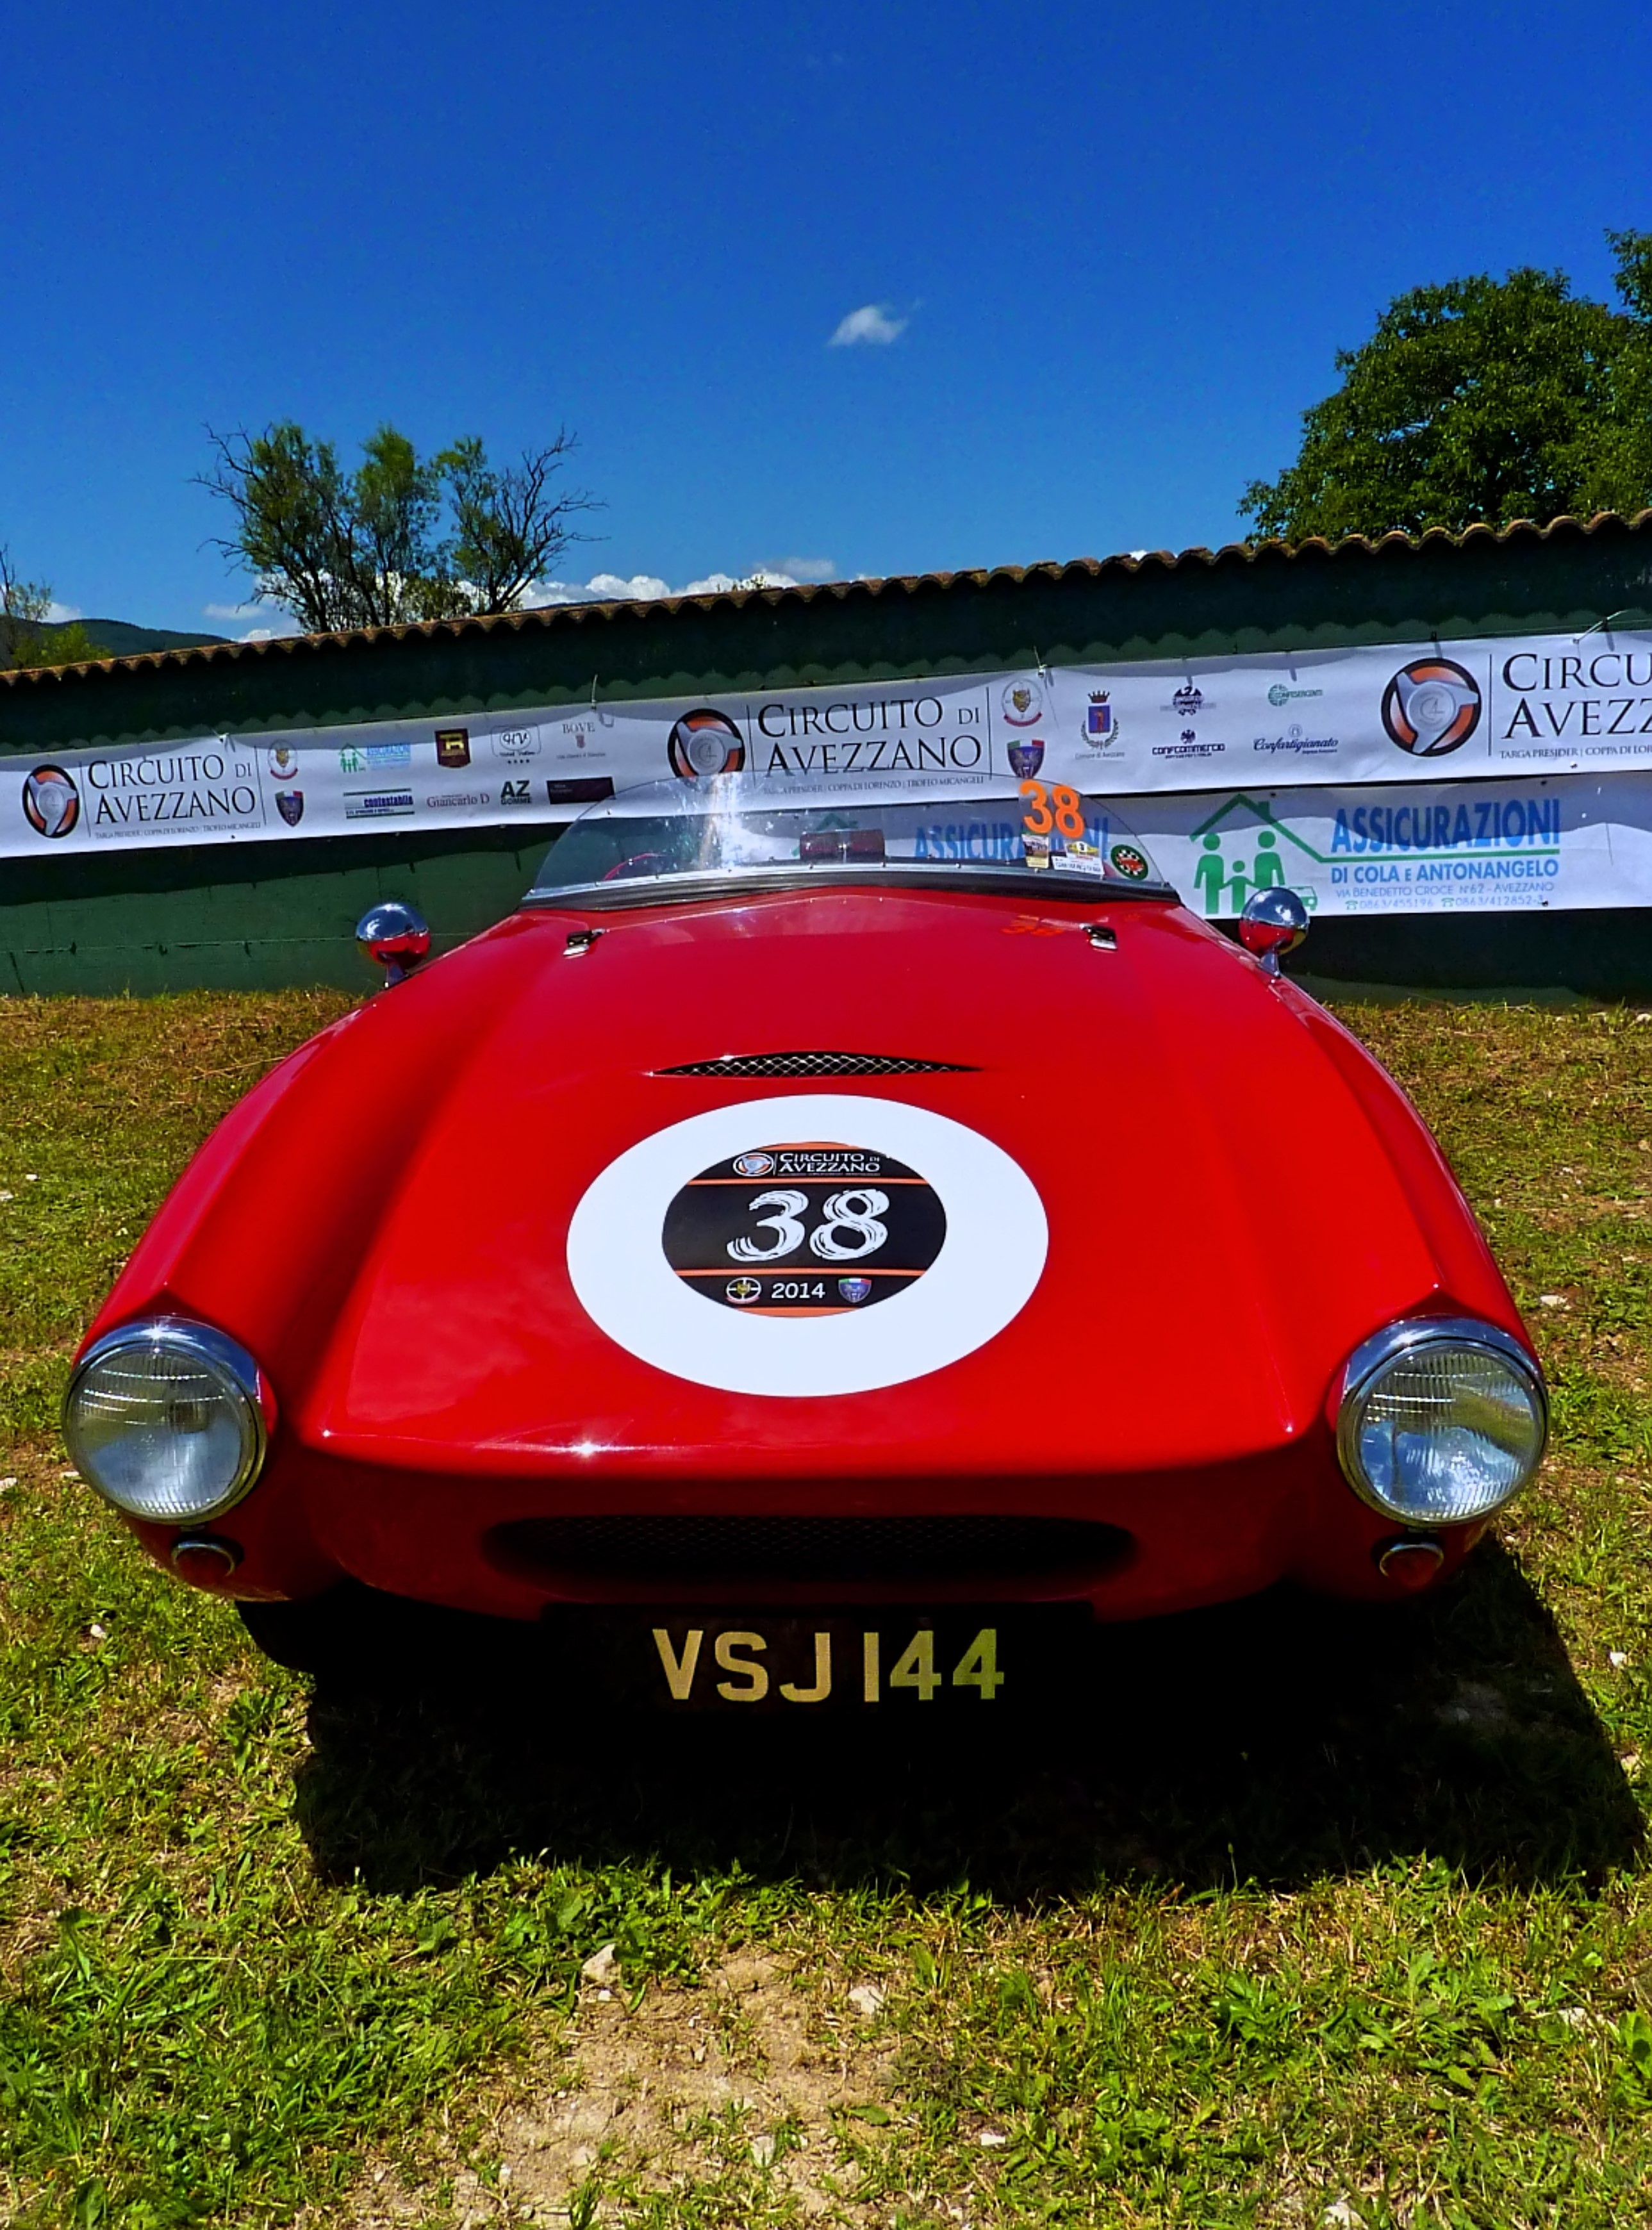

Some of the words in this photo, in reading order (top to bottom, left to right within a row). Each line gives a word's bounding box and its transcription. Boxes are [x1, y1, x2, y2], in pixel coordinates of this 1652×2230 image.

[562, 722, 595, 734] BOVE
[758, 697, 943, 738] CIRCUITO
[958, 707, 979, 724] DI
[1253, 737, 1339, 754] Confartigianato
[1501, 750, 1530, 759] TARGA
[1585, 746, 1617, 756] COPPA
[1619, 745, 1631, 754] DI
[766, 735, 981, 778] AVEZZANO
[88, 755, 224, 789] CIRCUITO
[235, 763, 251, 778] DI
[501, 780, 530, 798] AZ
[96, 786, 255, 824] AVEZZANO
[427, 795, 477, 807] Giancarlo
[1020, 779, 1085, 839] 38
[1330, 798, 1560, 853] ASSICURAZIONI
[1332, 868, 1347, 884] DI
[1355, 866, 1400, 884] COLA
[1405, 868, 1411, 882] E
[1417, 859, 1559, 882] ANTONANGELO
[1335, 888, 1350, 898] VIA
[1353, 886, 1412, 897] BENEDETTO
[1415, 885, 1453, 895] CROCE
[1494, 882, 1554, 893] AVEZZANO
[780, 1153, 864, 1162] CIRCUITO
[780, 1162, 880, 1172] AVEZZANO
[726, 1188, 889, 1262] 38
[772, 1282, 825, 1299] 2014
[652, 1628, 832, 1702] VSJ
